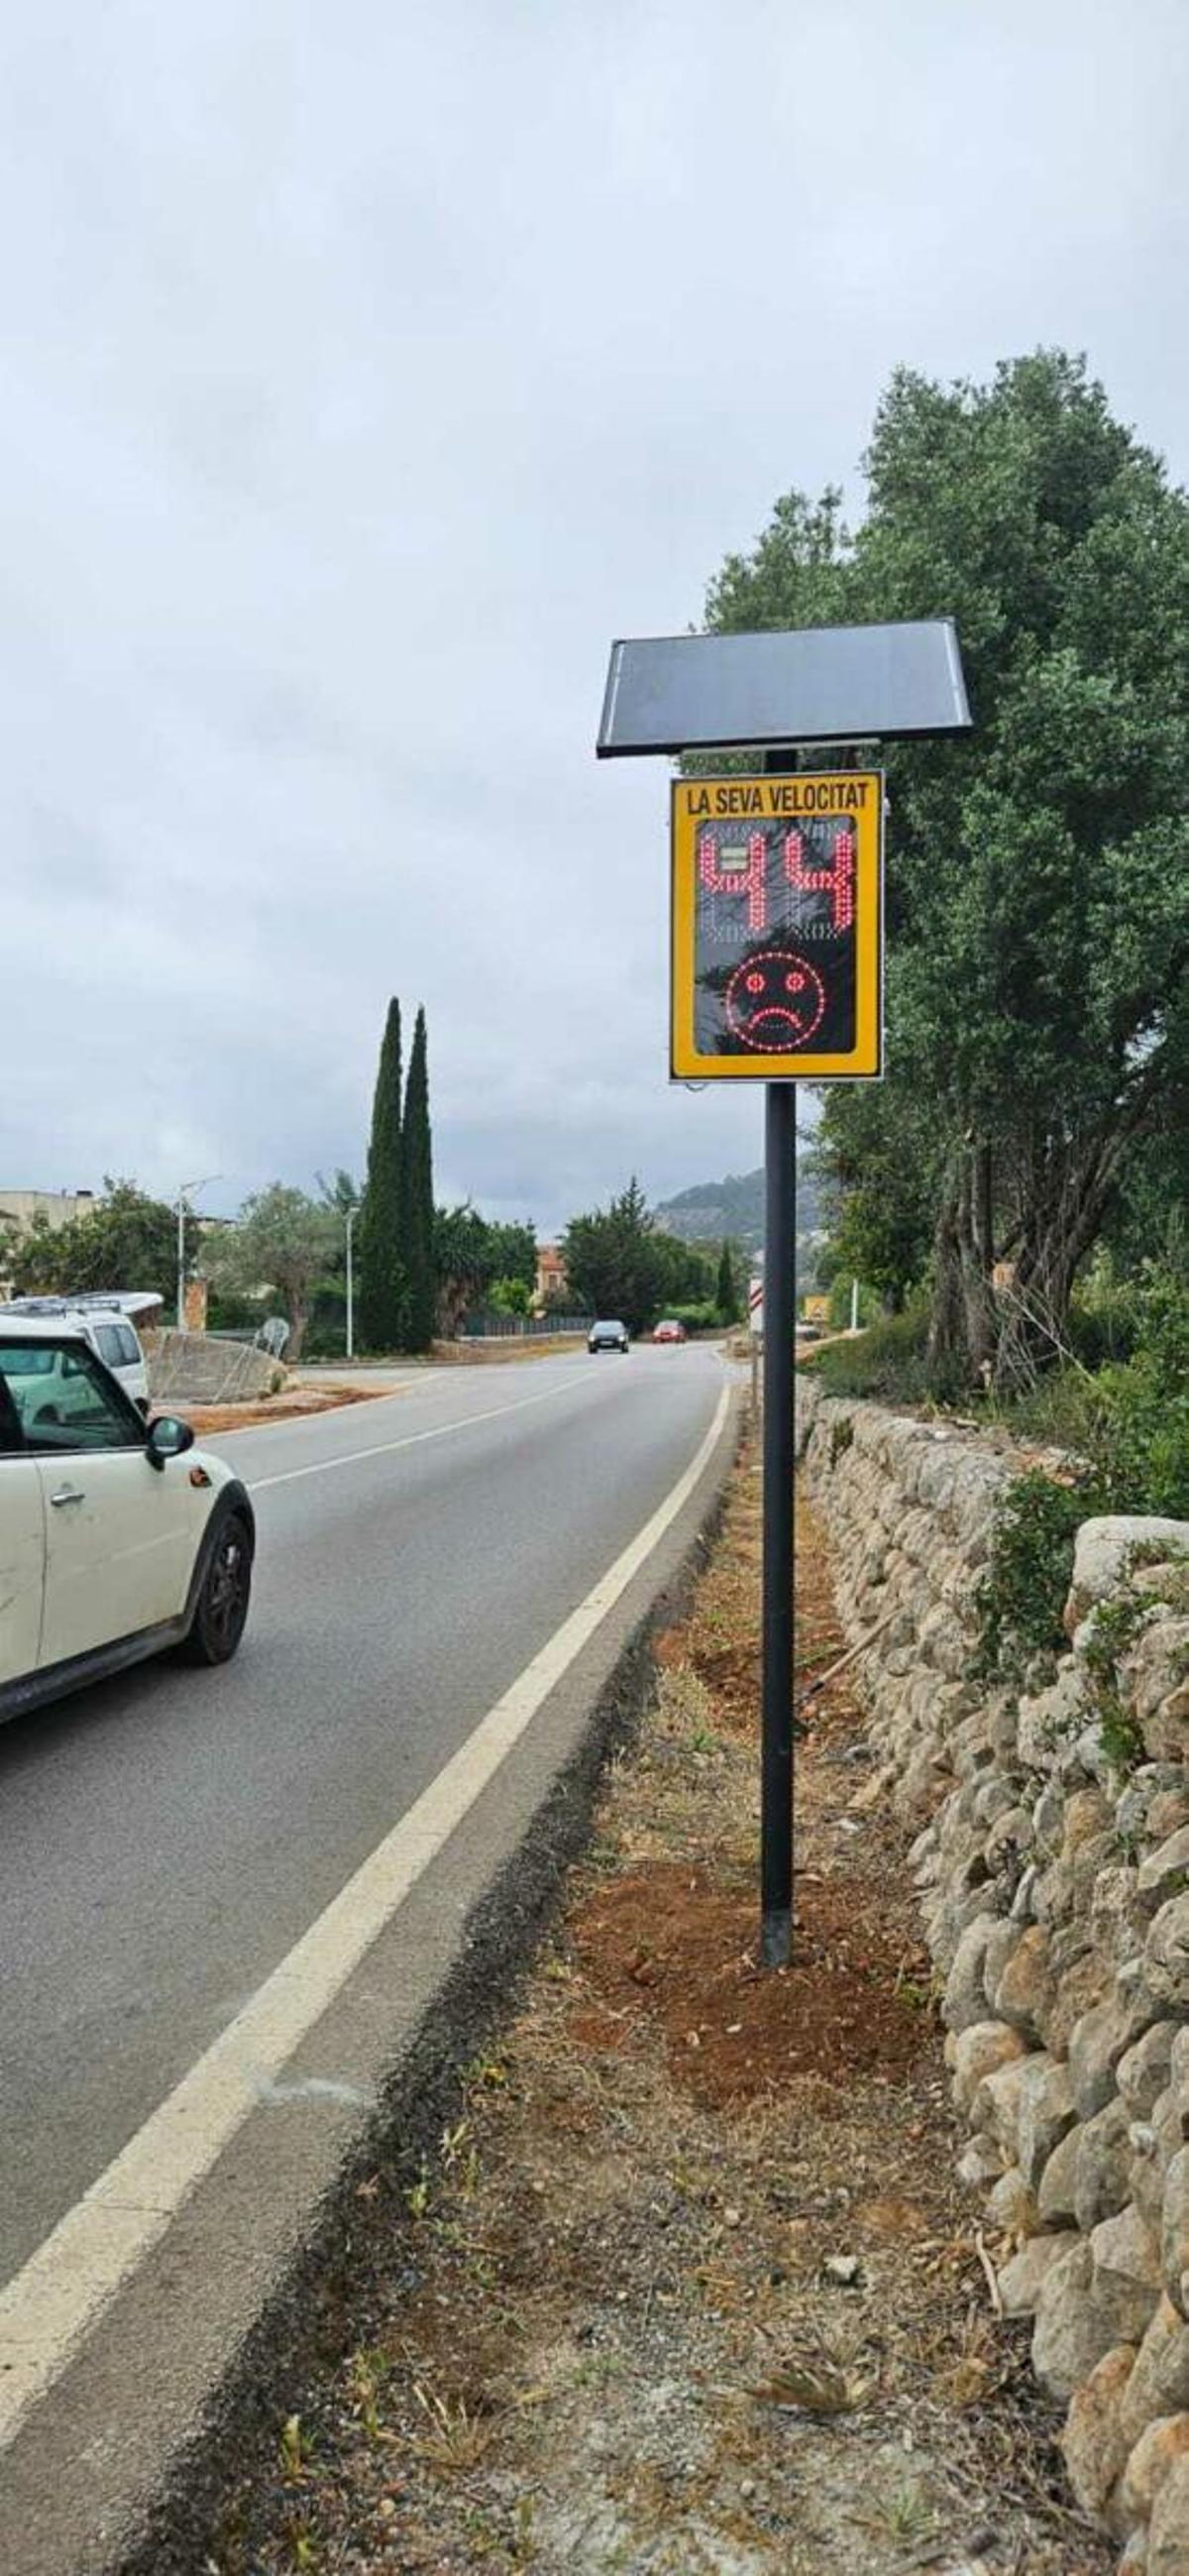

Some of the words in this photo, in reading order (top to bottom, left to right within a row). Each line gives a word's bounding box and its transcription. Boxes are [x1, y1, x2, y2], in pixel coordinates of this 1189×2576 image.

[687, 790, 711, 815] LA
[716, 787, 762, 813] SEVA
[770, 782, 869, 811] VELOCITAT
[700, 831, 853, 931] 44
